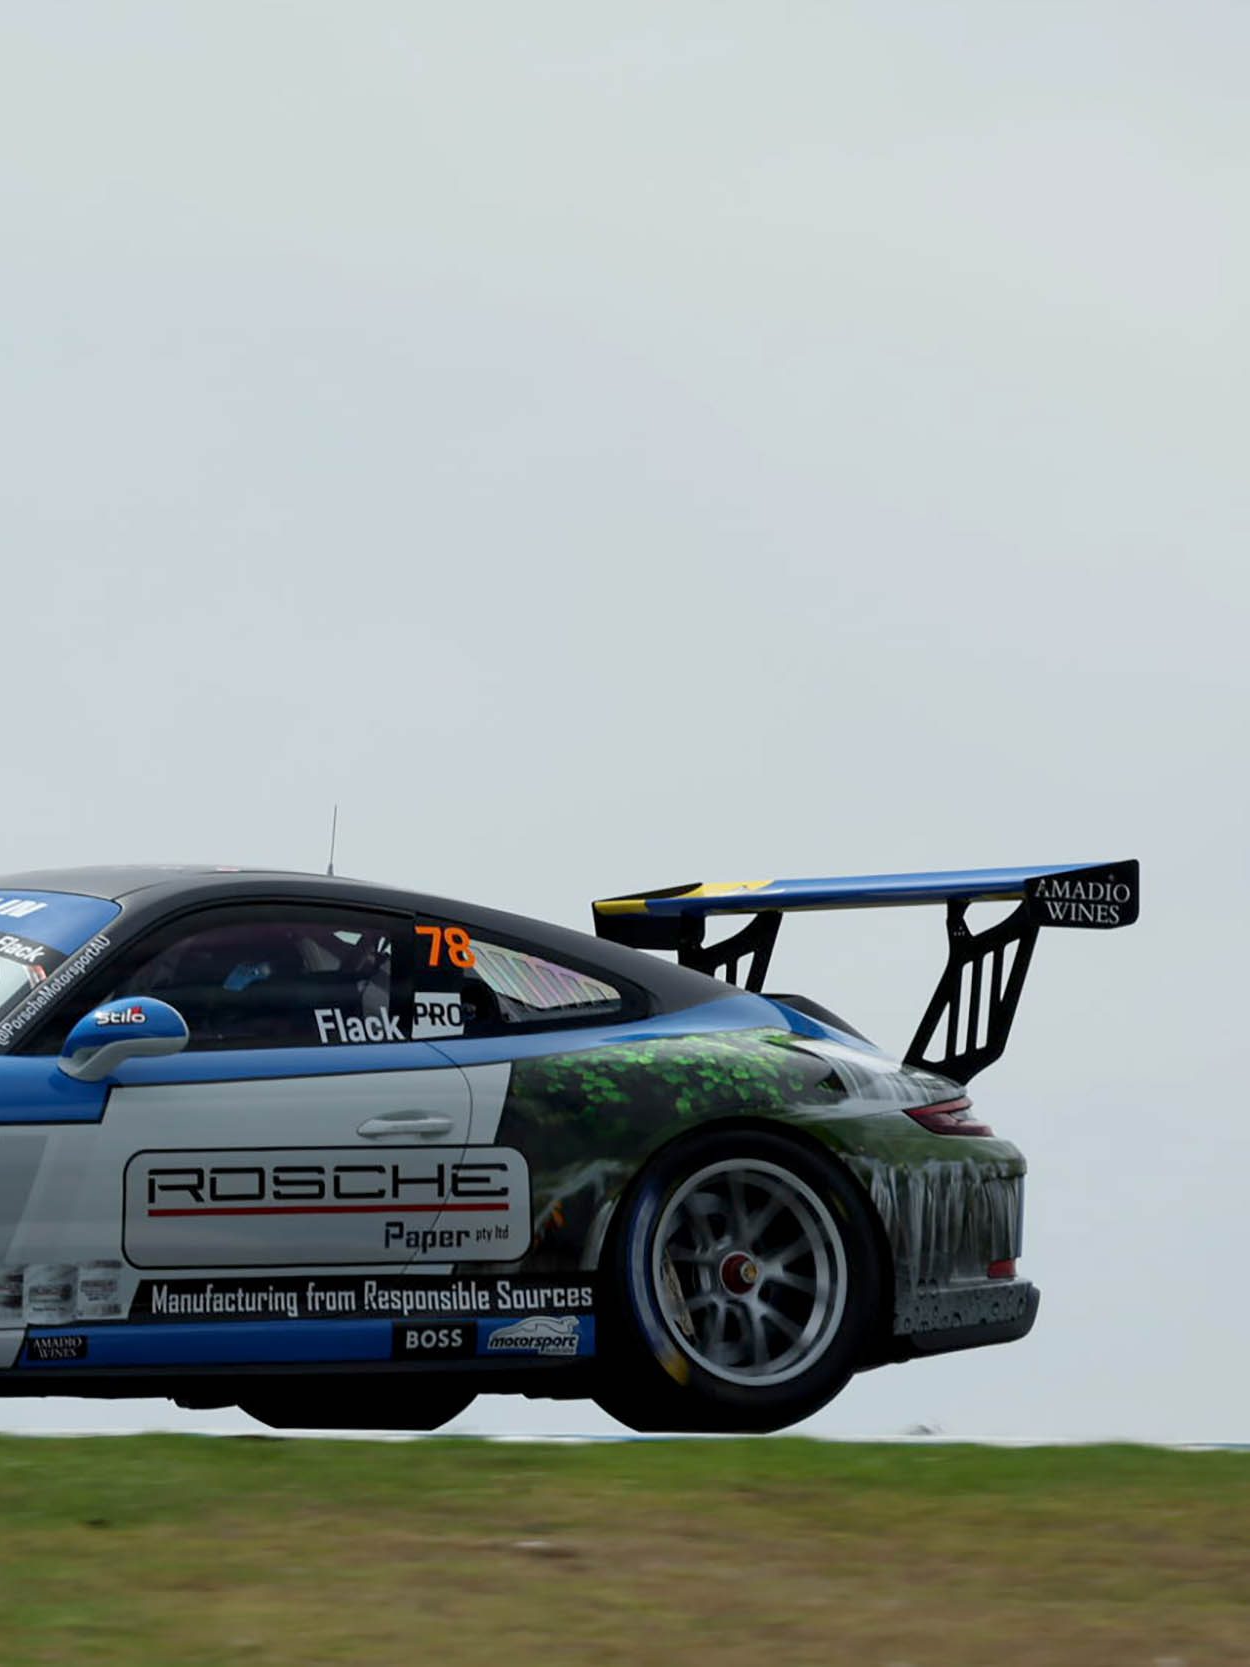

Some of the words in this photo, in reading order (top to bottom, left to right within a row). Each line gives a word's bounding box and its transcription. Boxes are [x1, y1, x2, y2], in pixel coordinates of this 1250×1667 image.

[1035, 878, 1131, 903] AMADIO
[1046, 901, 1121, 925] WINES
[414, 925, 477, 969] 78
[314, 1006, 407, 1043] Flack
[413, 1002, 464, 1027] PRO
[147, 1163, 509, 1203] ROSCHE
[384, 1221, 470, 1253] Paper
[476, 1228, 493, 1242] pty
[495, 1224, 509, 1240] ltd
[152, 1284, 299, 1318] Manufacturing
[306, 1282, 357, 1312] from
[364, 1280, 491, 1316] Responsible
[497, 1280, 593, 1310] Sources
[32, 1336, 82, 1350] AMADIO
[405, 1329, 463, 1350] BOSS
